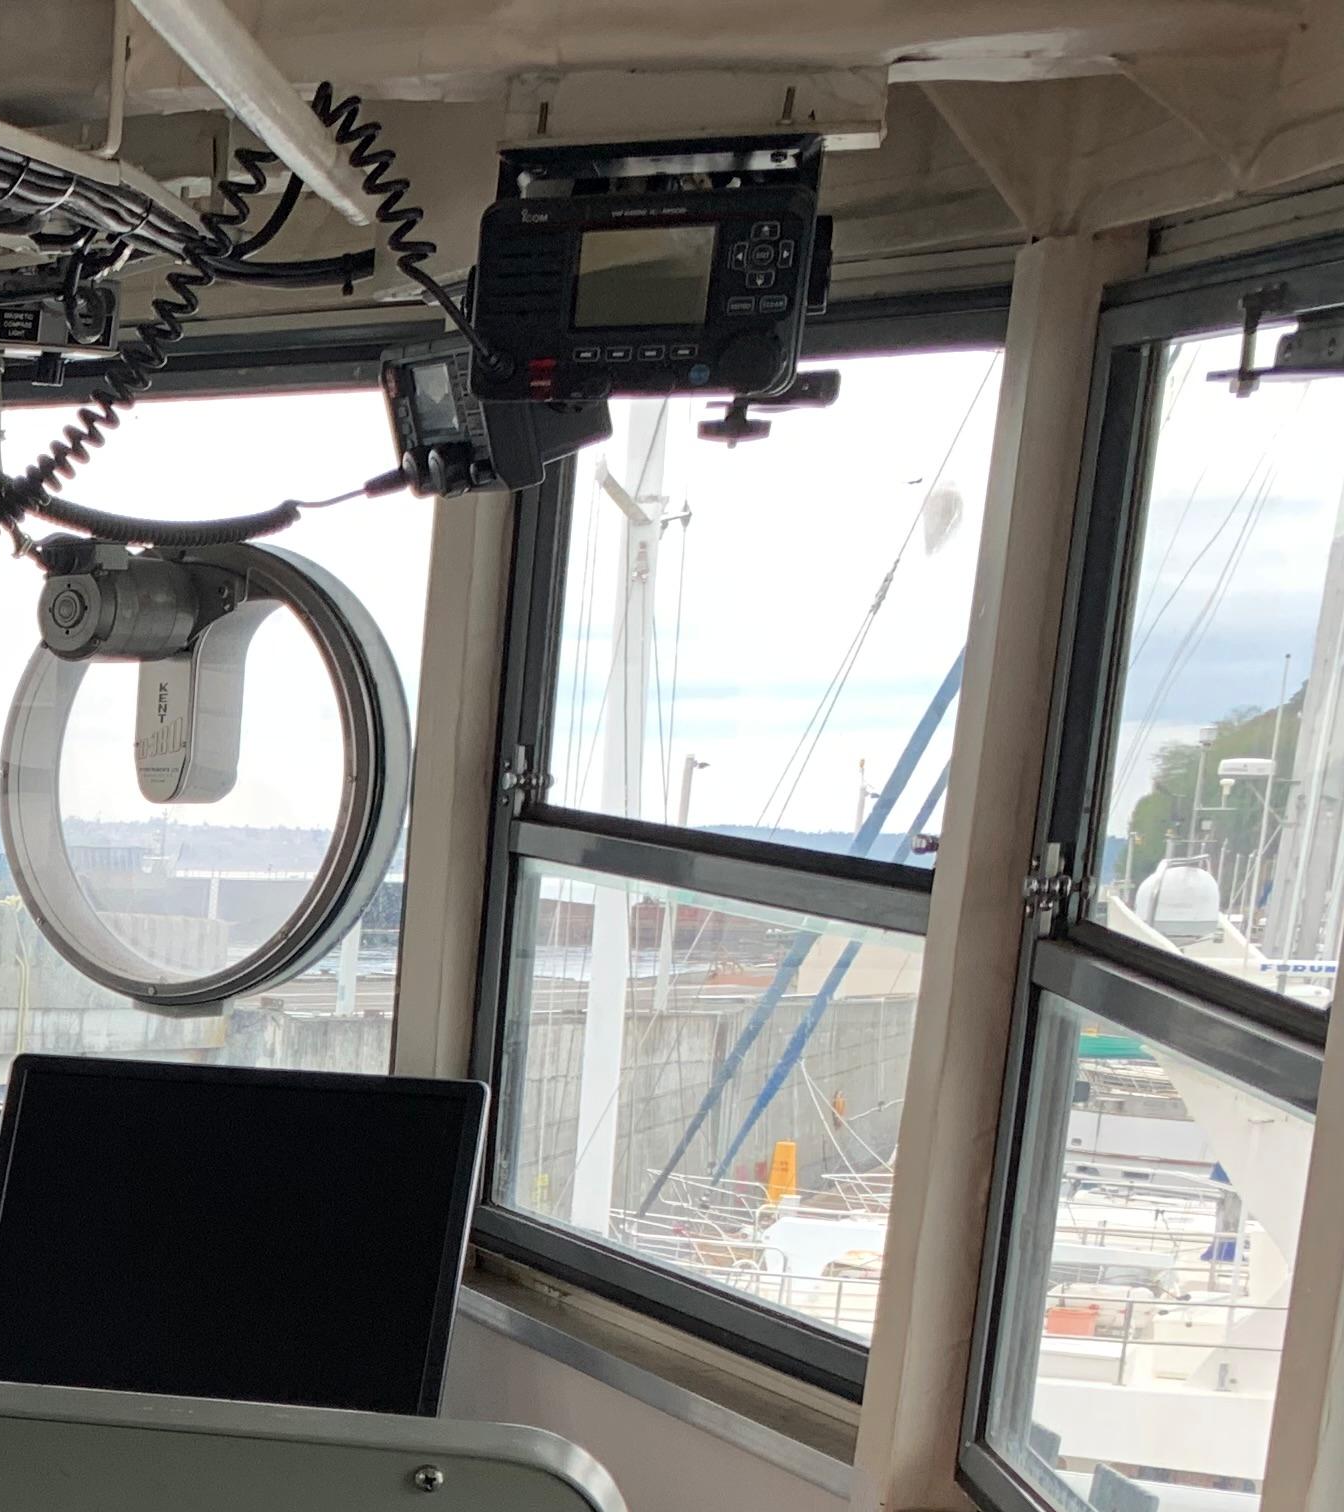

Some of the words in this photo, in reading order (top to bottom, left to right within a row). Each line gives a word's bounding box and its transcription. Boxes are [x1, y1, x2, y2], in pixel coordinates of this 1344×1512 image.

[4, 312, 33, 320] MAGNETIC
[3, 321, 33, 329] COMPASS
[157, 682, 169, 724] KENT
[1260, 963, 1337, 973] FURUN
